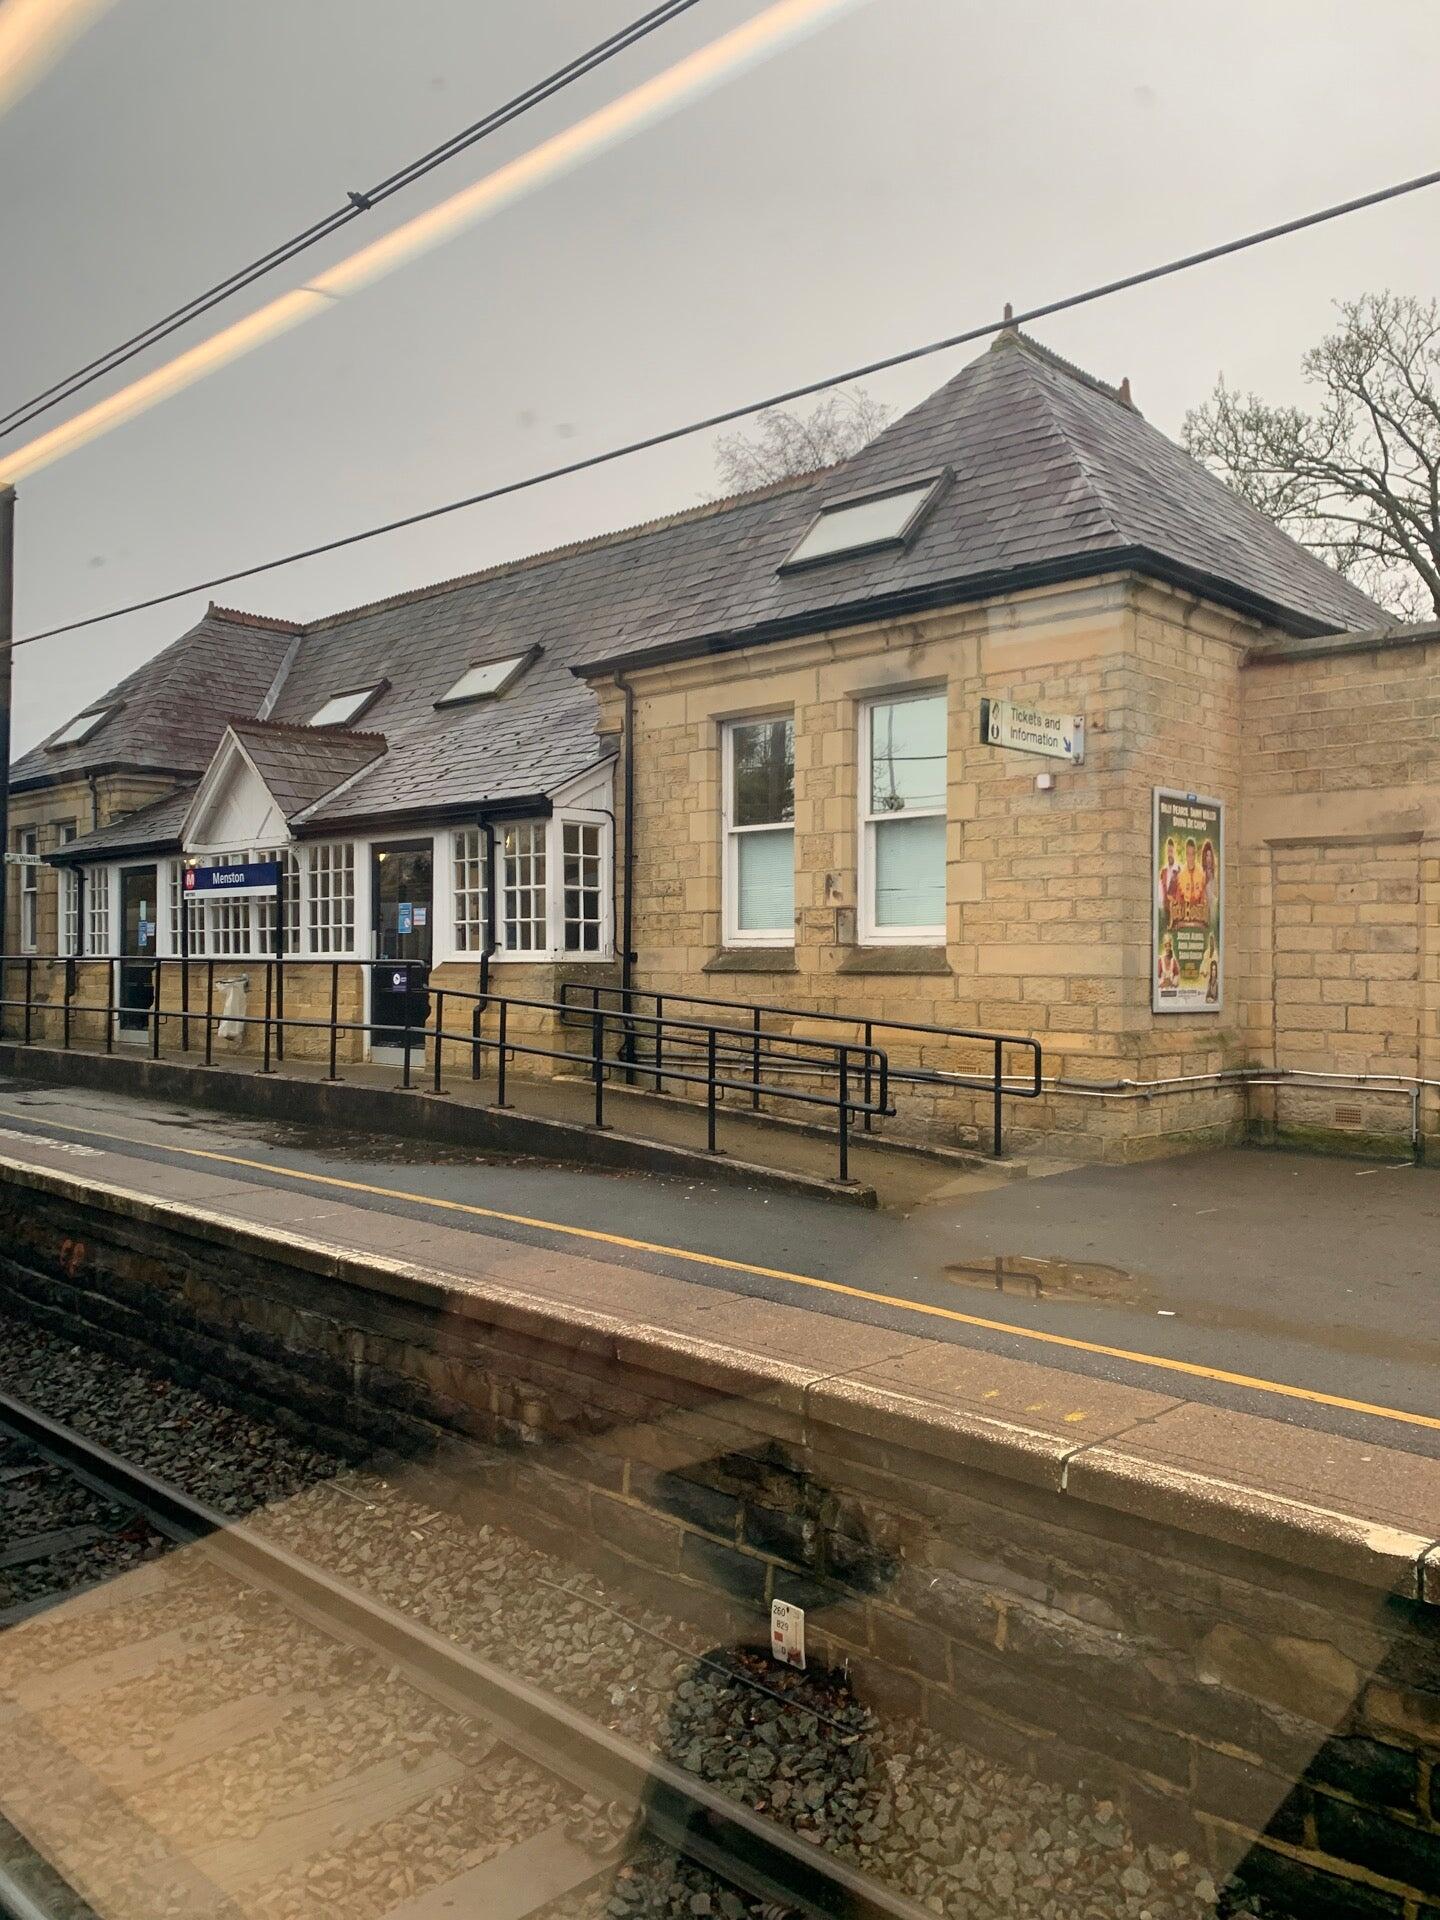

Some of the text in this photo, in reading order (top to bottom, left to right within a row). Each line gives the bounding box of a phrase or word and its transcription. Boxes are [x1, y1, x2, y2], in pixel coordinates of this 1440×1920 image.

[1011, 707, 1061, 731] Tickets and
[1010, 726, 1058, 747] Information
[19, 854, 40, 863] Wait
[212, 872, 245, 885] Menston
[773, 1605, 786, 1617] 260
[776, 1619, 789, 1632] 829
